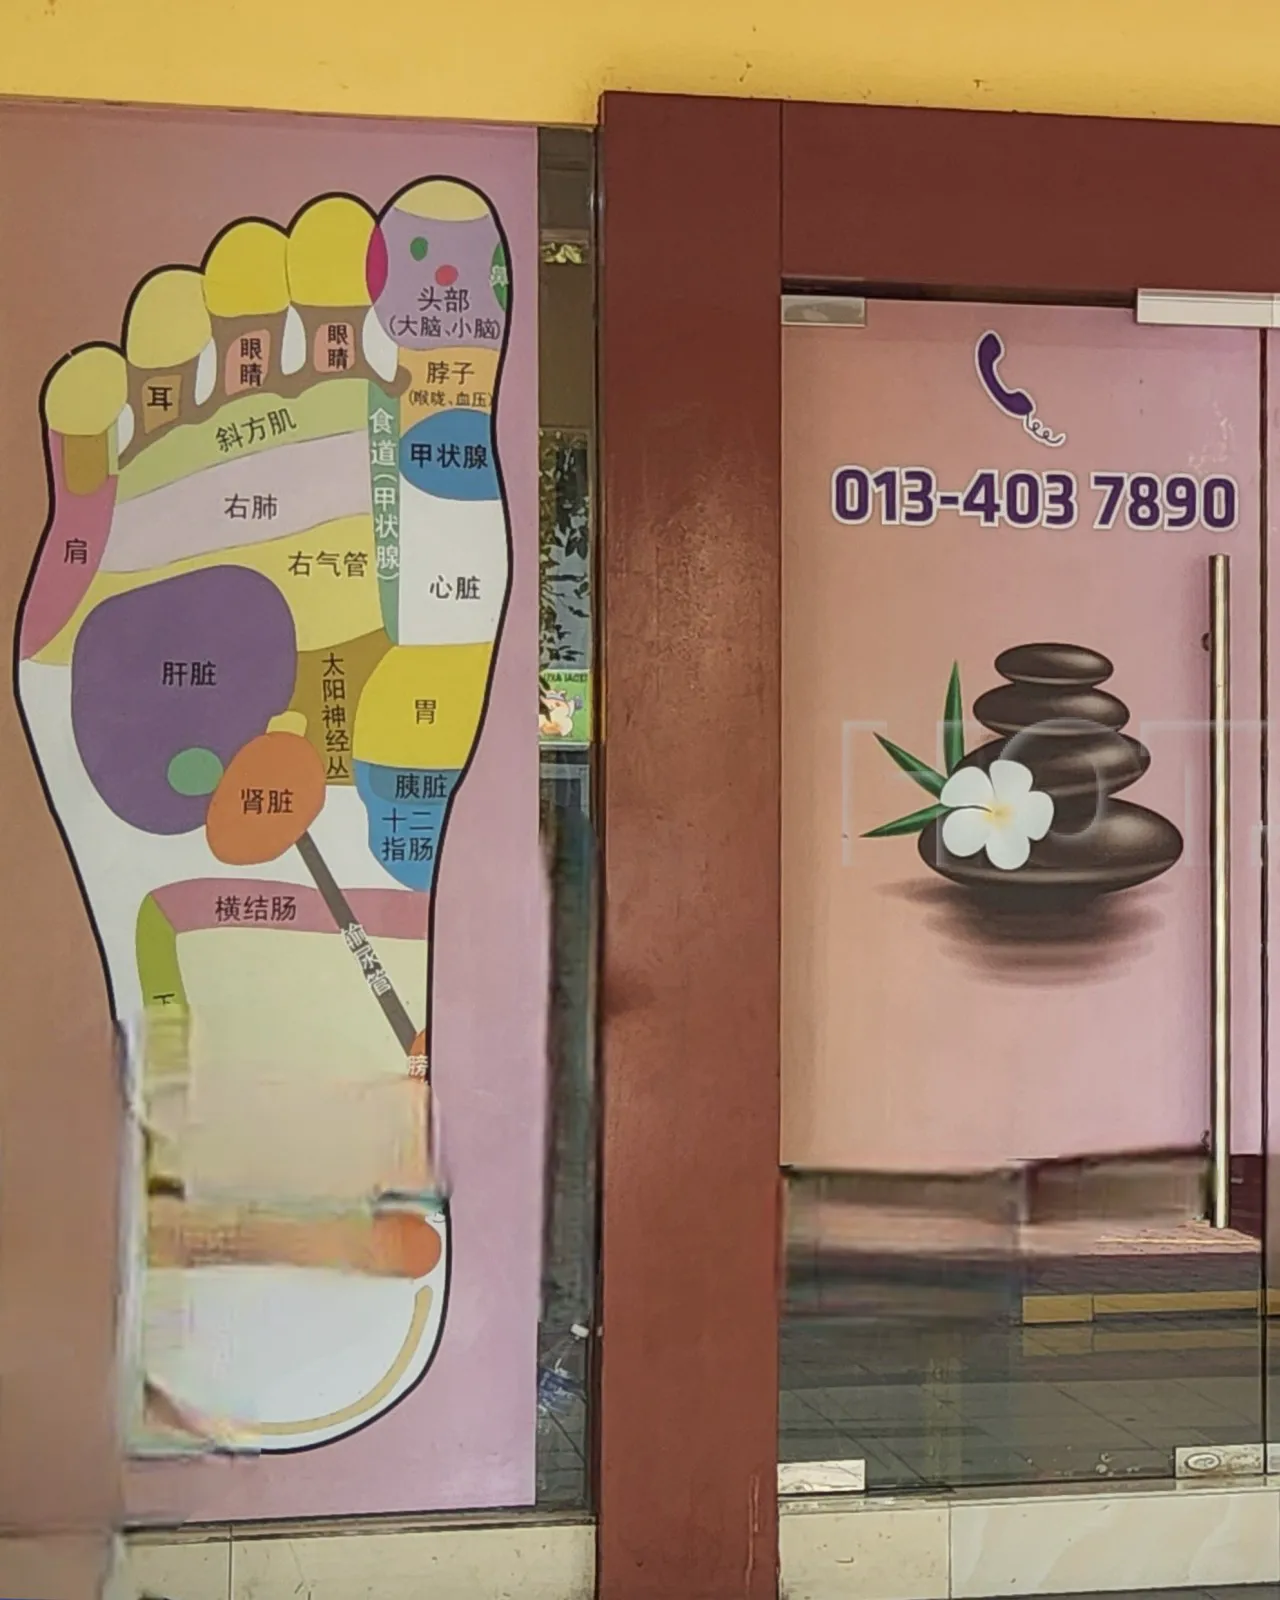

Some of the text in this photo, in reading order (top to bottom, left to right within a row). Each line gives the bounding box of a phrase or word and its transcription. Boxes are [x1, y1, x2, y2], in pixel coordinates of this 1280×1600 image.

[417, 286, 470, 313] 头部
[327, 324, 349, 370] 眼睛
[240, 338, 263, 387] 眼睛
[426, 361, 475, 386] 脖子
[147, 386, 173, 411] 耳
[215, 408, 297, 453] 斜方肌
[411, 443, 488, 470] 甲状腺
[224, 494, 278, 520] 右肺
[833, 467, 1237, 530] 013-403 7890
[64, 539, 88, 564] 肩
[288, 551, 368, 578] 右气管
[429, 575, 480, 600] 心脏
[162, 661, 217, 687] 肝脏
[321, 652, 350, 780] 太阳神经丛
[415, 699, 436, 725] 胃
[395, 773, 447, 799] 胰脏
[240, 788, 294, 814] 肾脏
[382, 808, 434, 833] 十二
[382, 837, 433, 861] 指肠
[214, 896, 296, 921] 横结肠
